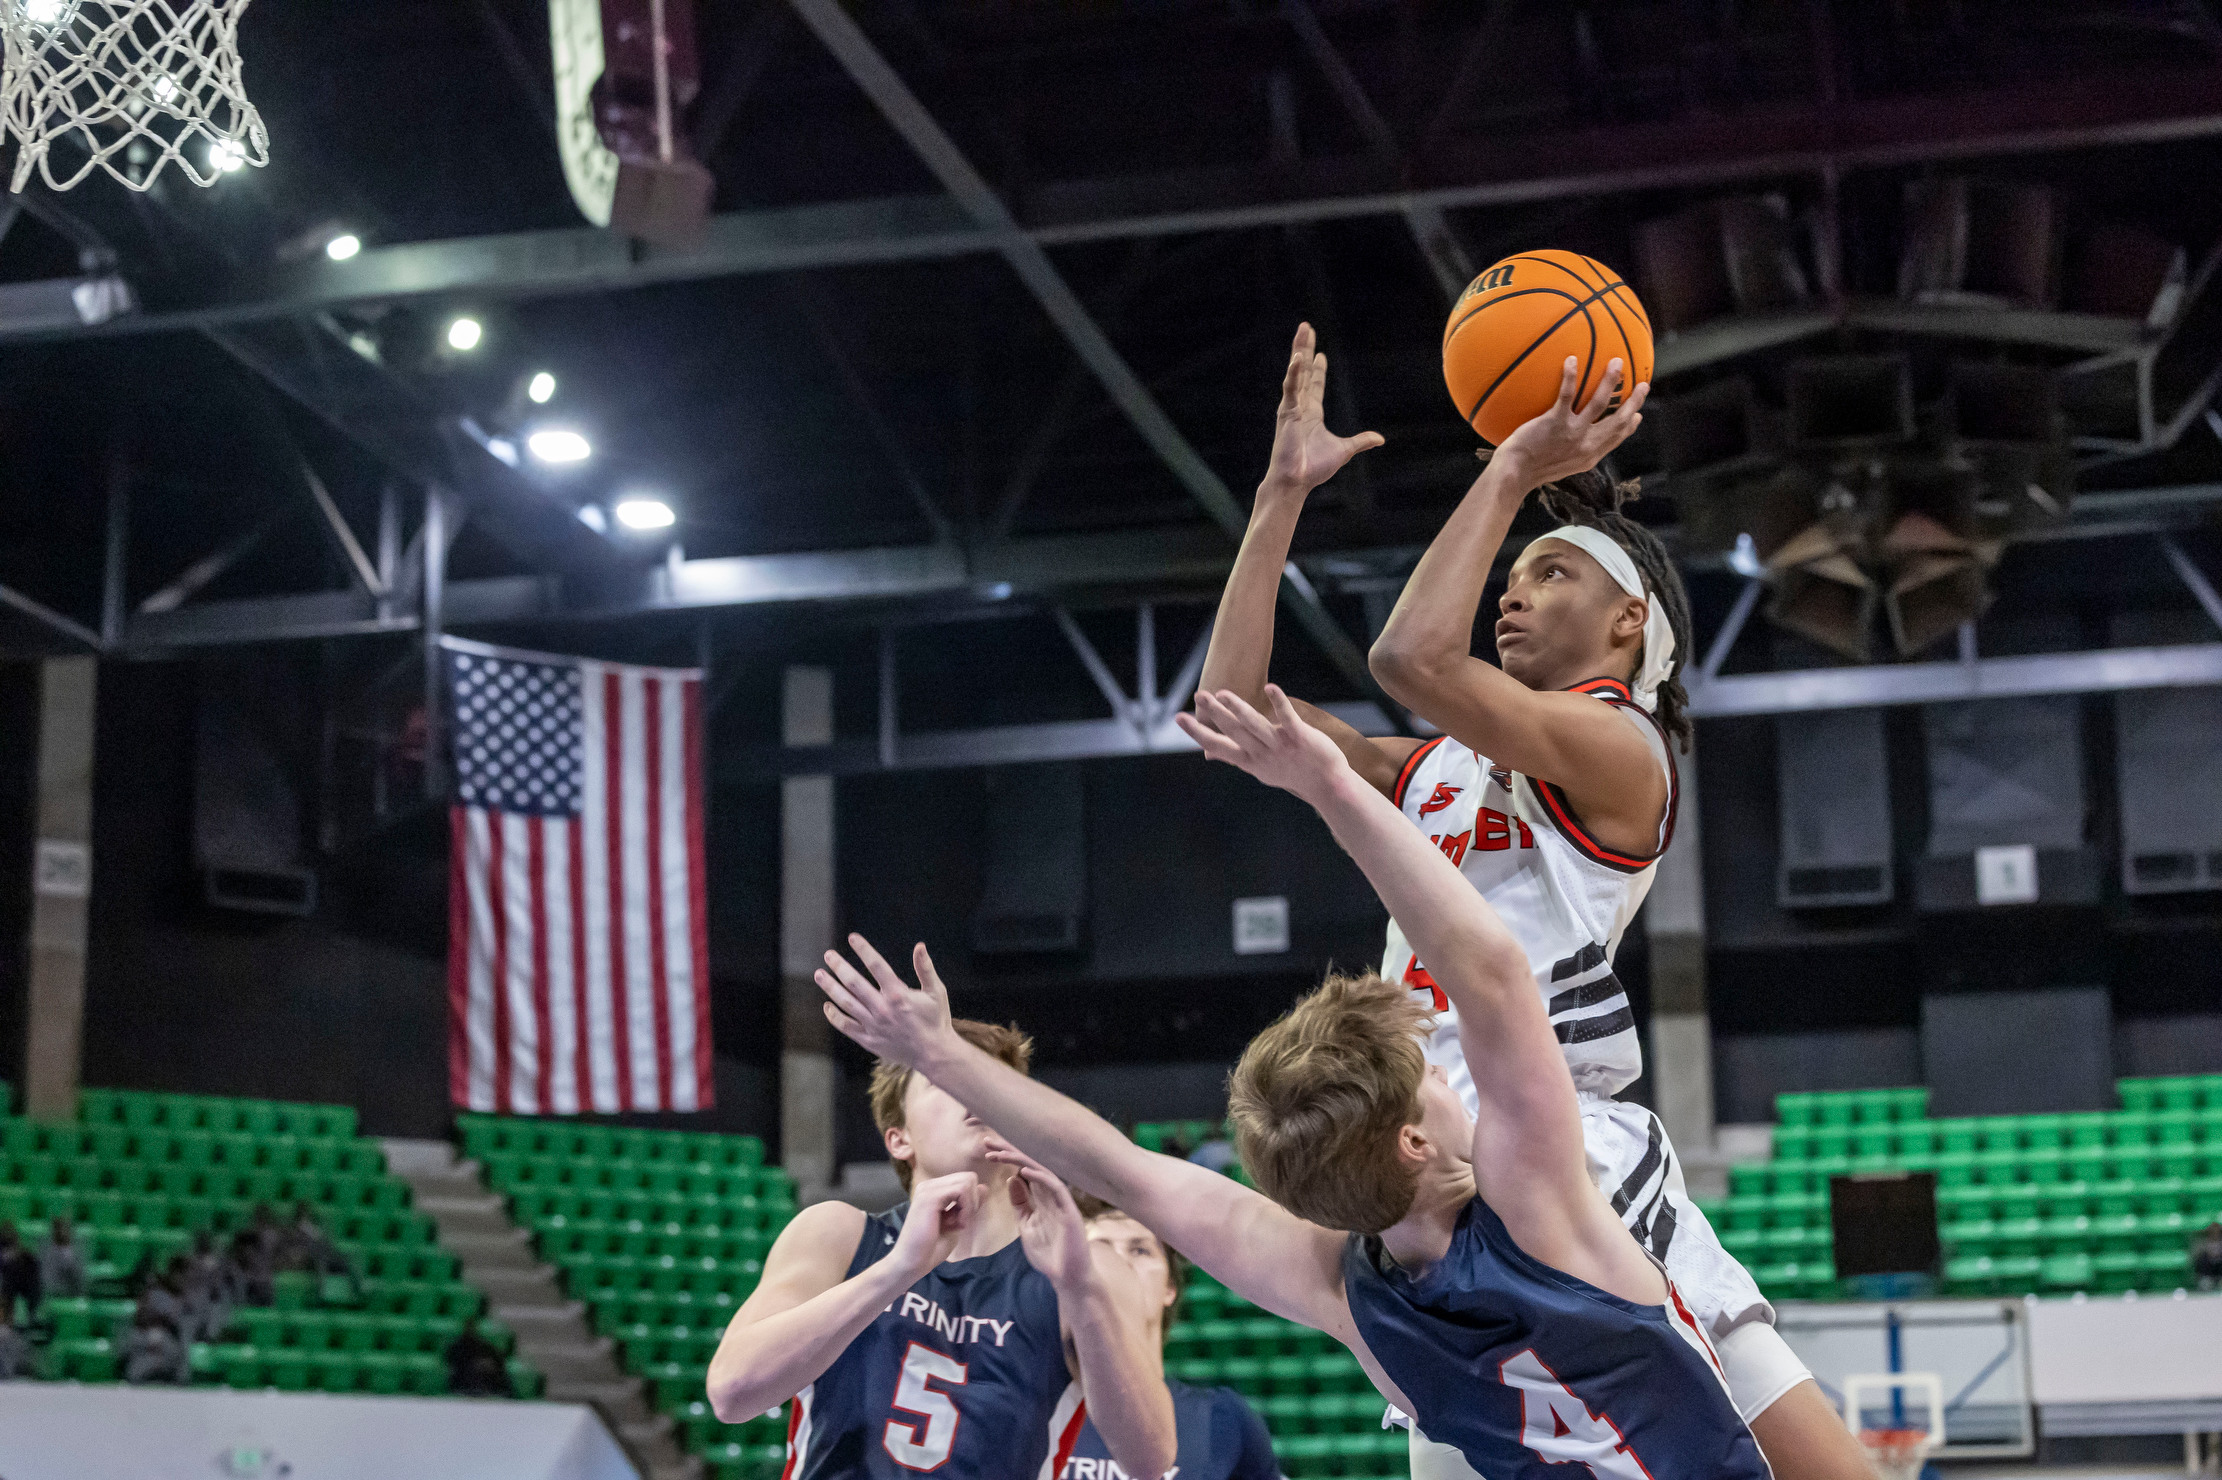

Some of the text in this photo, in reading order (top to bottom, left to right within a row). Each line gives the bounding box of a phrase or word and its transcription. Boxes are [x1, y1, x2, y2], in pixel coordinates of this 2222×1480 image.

[884, 1291, 1015, 1347] RINITY
[882, 1339, 970, 1475] 5
[1498, 1348, 1655, 1480] 4
